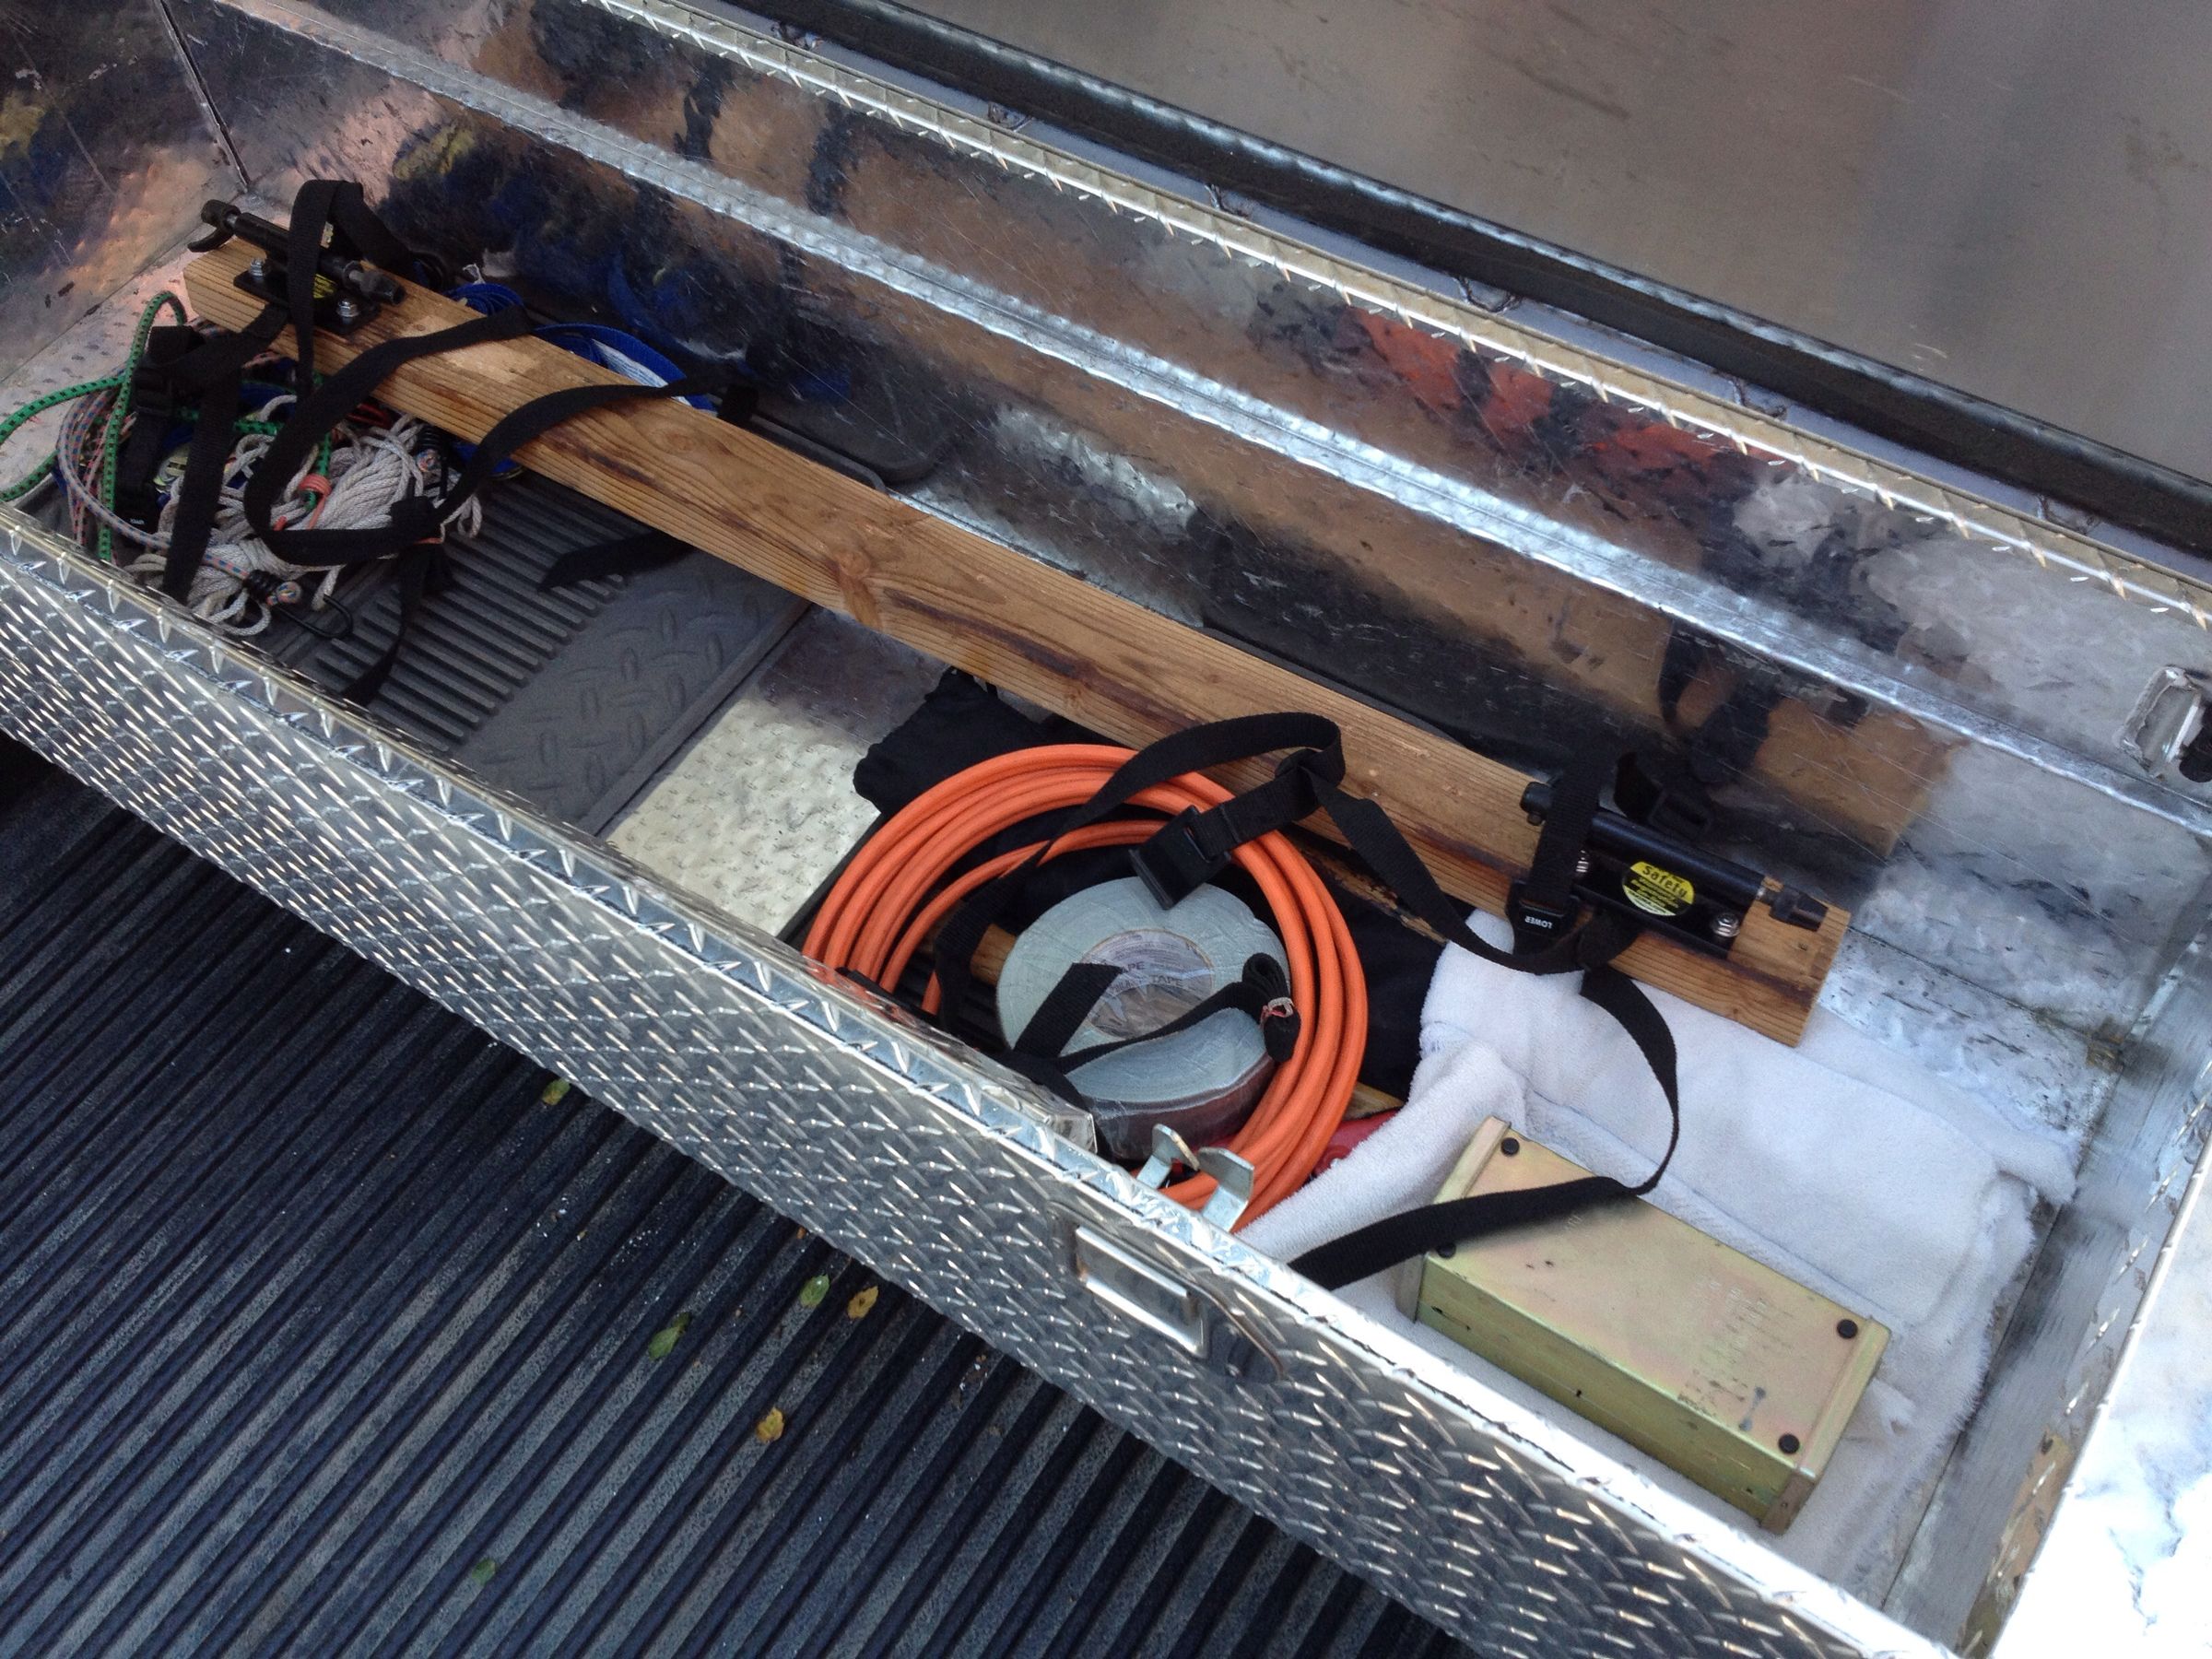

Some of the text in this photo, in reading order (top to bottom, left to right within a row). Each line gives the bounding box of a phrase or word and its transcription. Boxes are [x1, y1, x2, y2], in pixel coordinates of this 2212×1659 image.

[1642, 865, 1688, 897] Safety
[1524, 915, 1553, 929] LOWER
[1122, 960, 1146, 973] APE
[1152, 974, 1183, 987] TAPE
